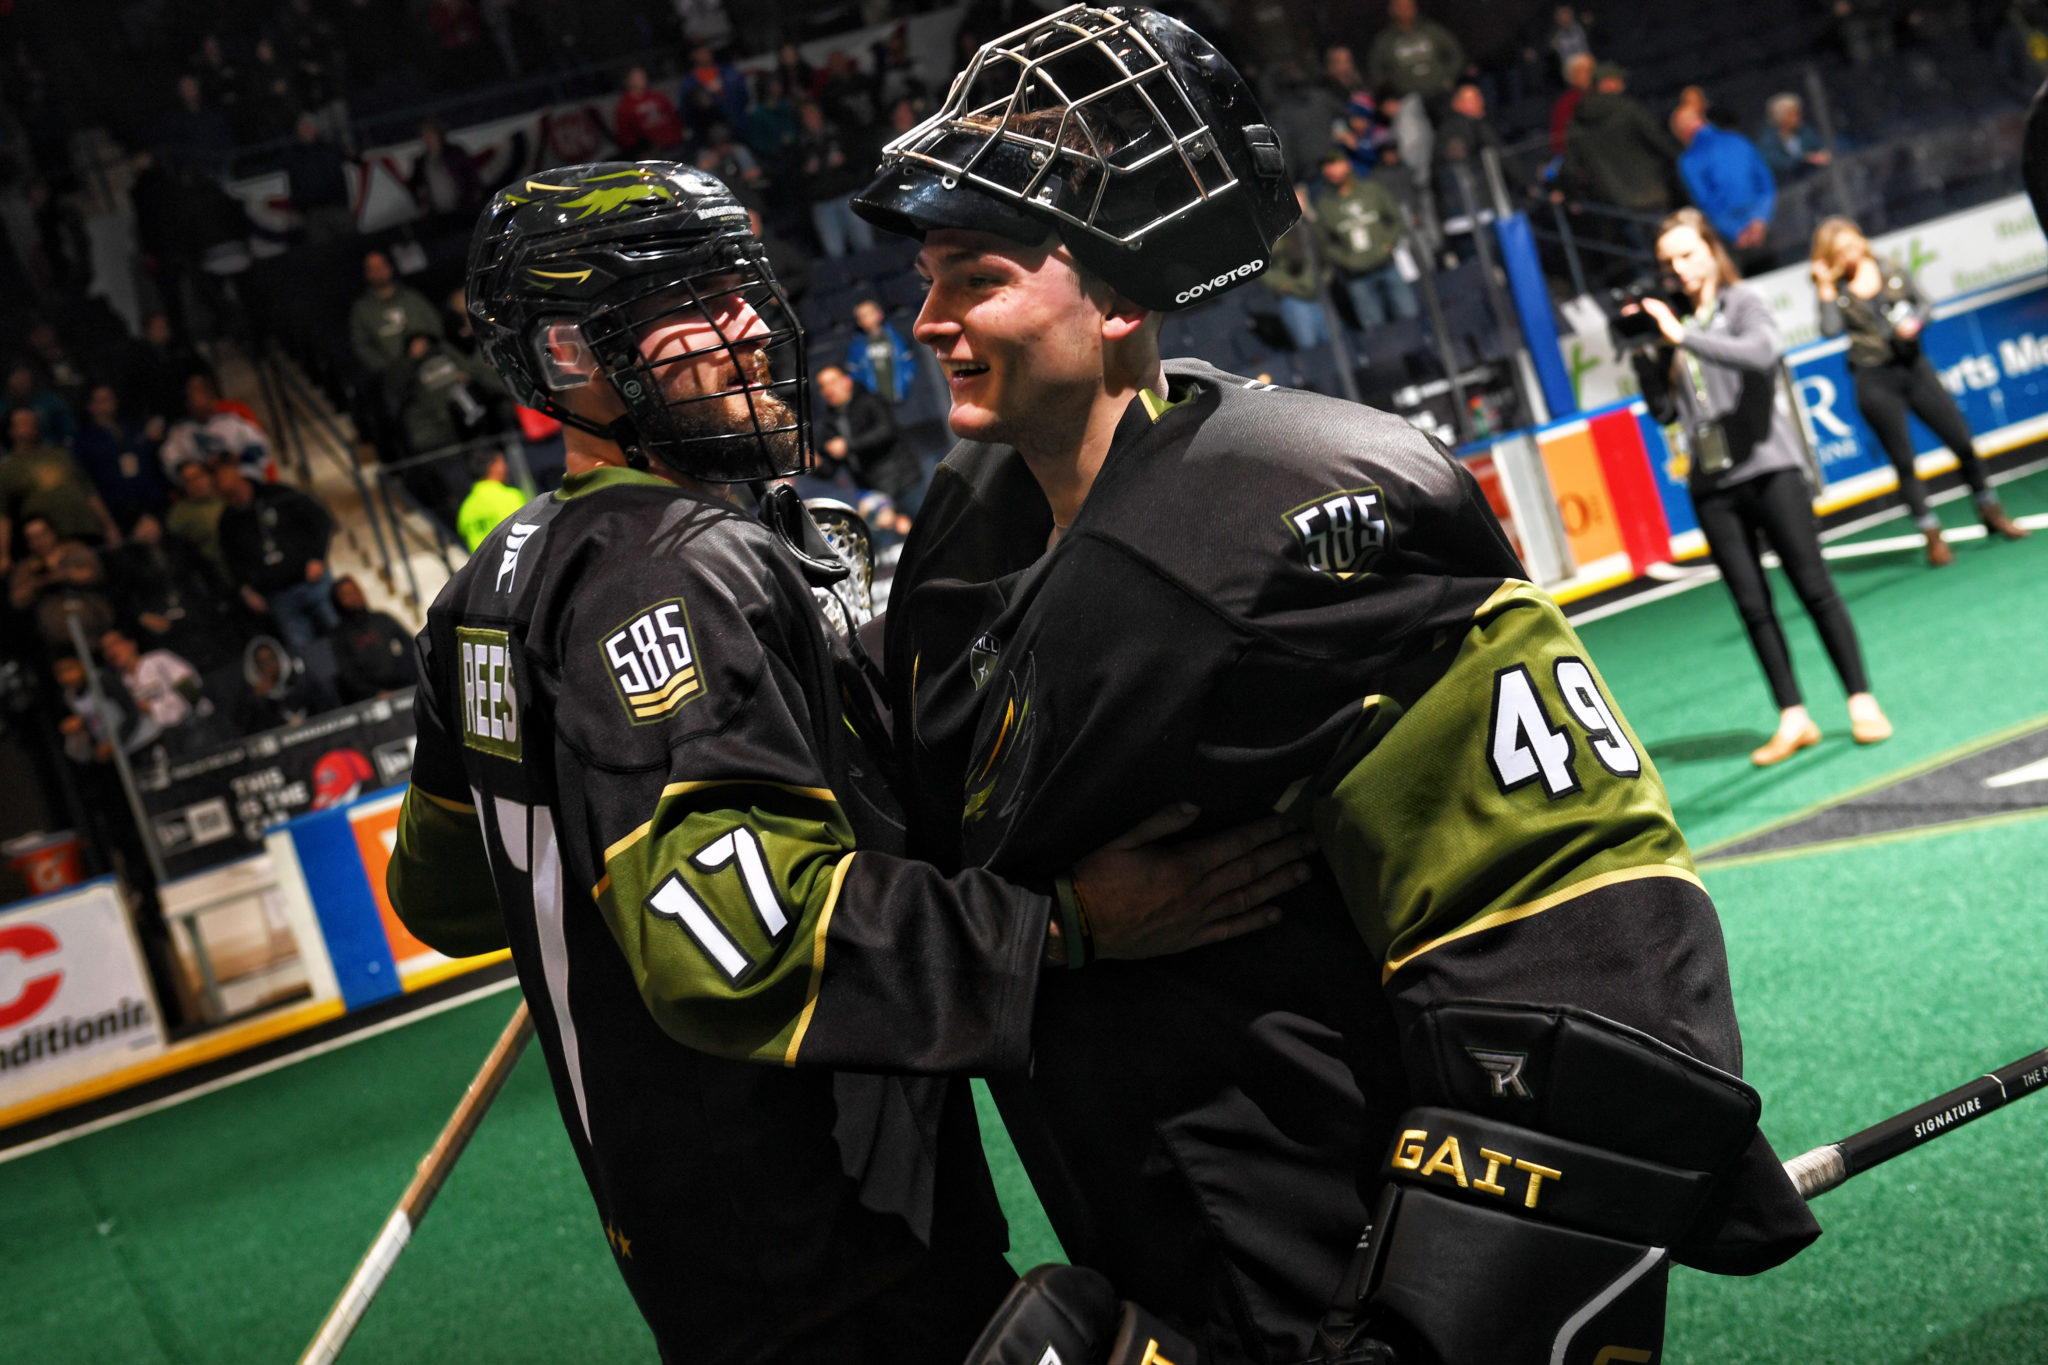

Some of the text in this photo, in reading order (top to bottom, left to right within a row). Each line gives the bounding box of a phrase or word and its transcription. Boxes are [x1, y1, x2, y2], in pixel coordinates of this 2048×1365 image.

[1293, 494, 1385, 572] 585
[462, 642, 517, 743] REES
[605, 604, 692, 694] 585
[1490, 657, 1640, 798] 49
[647, 825, 792, 983] 17
[1914, 1097, 1982, 1138] SIGNATURE
[2022, 1069, 2042, 1088] THE
[1391, 1129, 1562, 1208] GAIT
